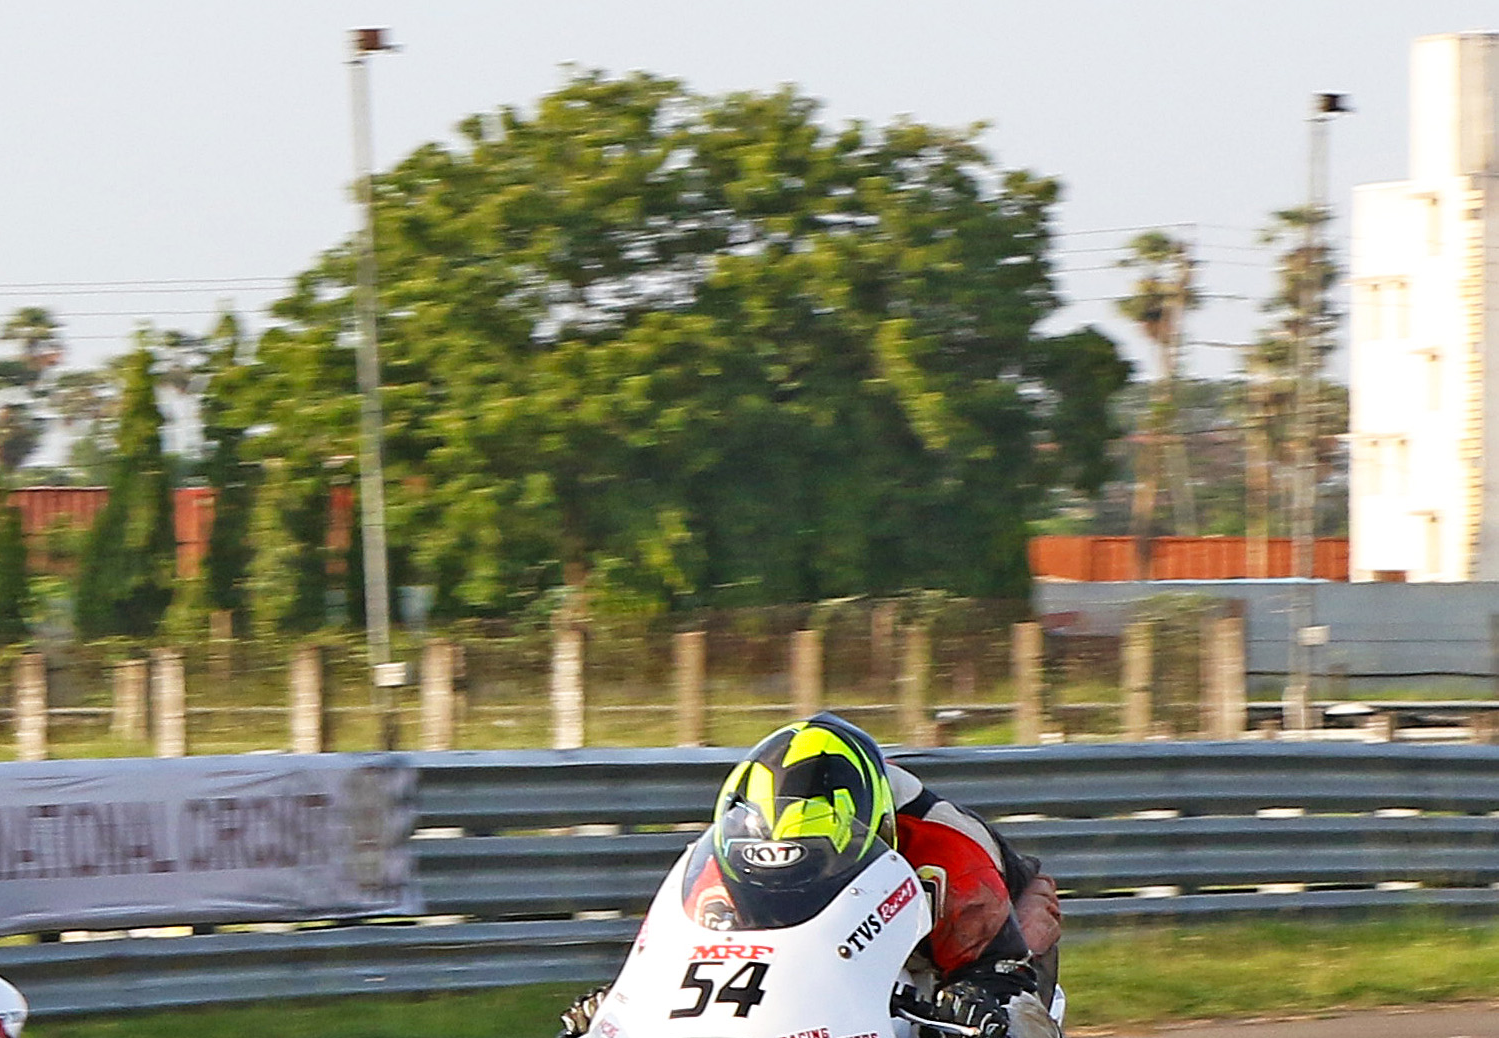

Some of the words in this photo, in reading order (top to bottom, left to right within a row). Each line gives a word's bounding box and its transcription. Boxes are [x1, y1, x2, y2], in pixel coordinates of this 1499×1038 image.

[746, 844, 801, 863] KYT
[846, 914, 882, 952] TVS
[688, 945, 774, 960] MRF
[669, 961, 770, 1019] 54
